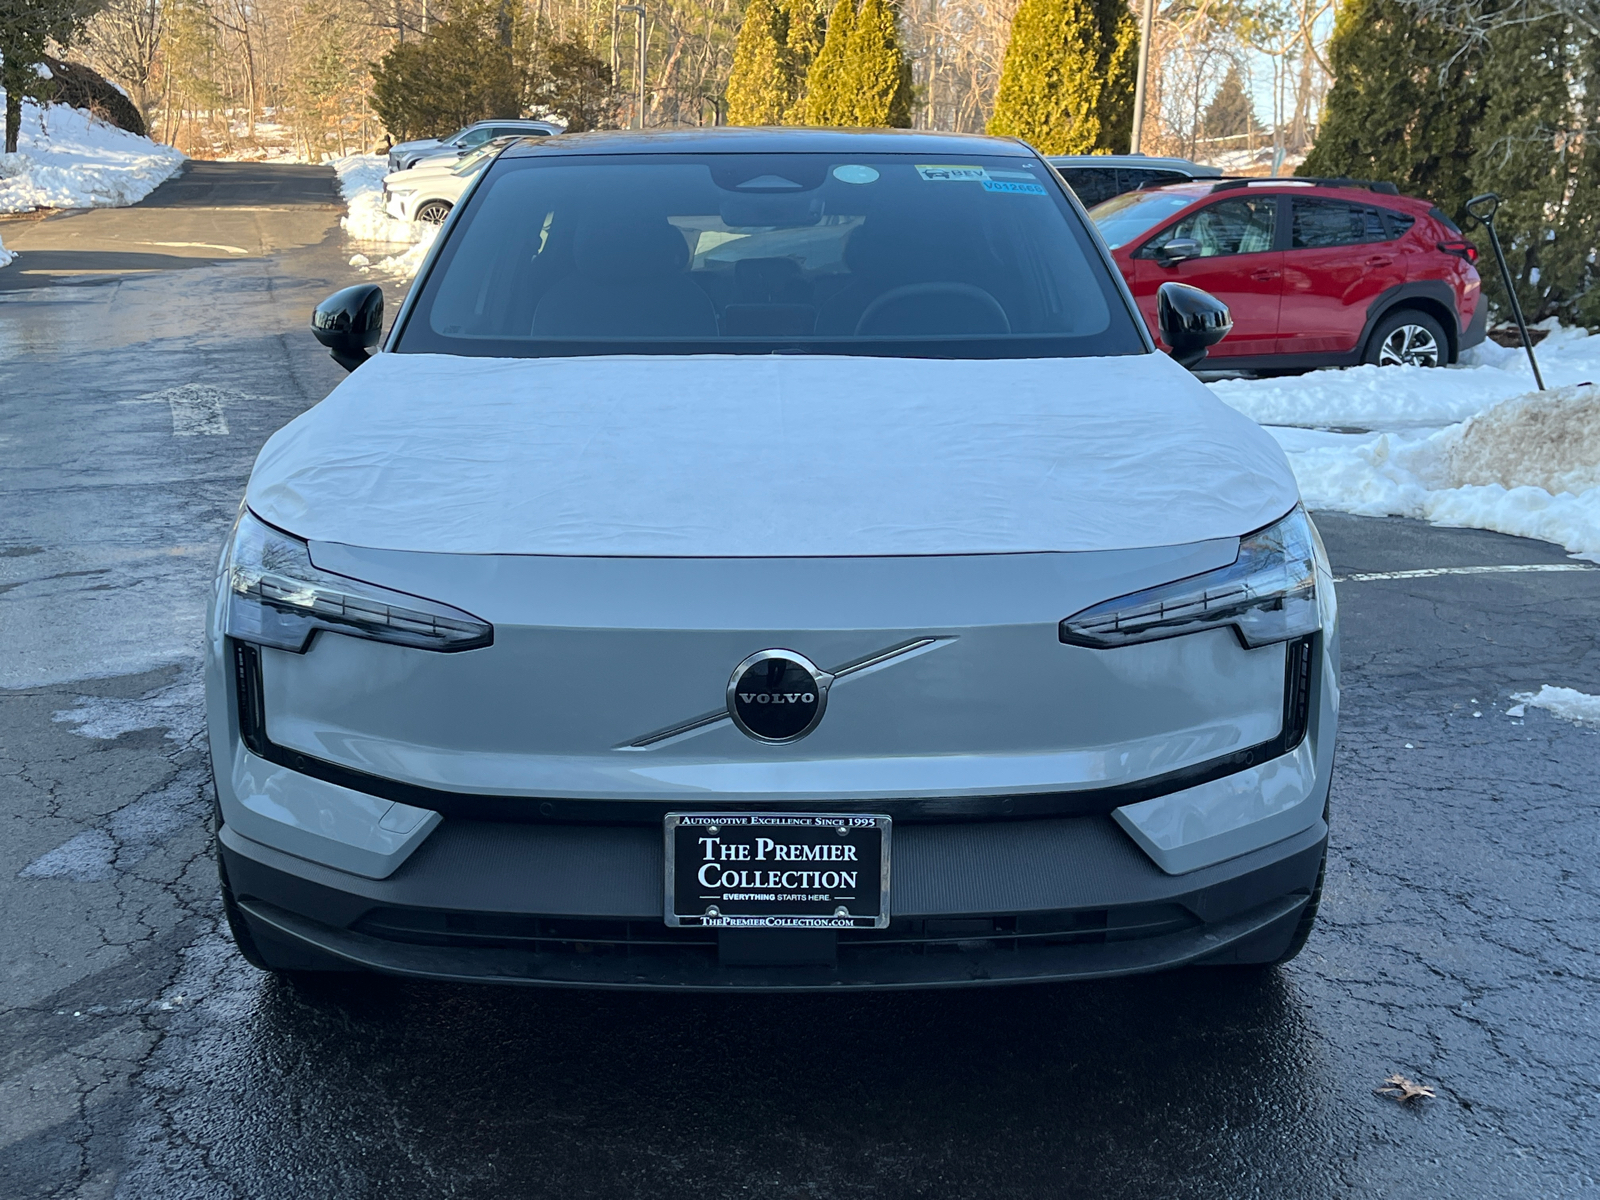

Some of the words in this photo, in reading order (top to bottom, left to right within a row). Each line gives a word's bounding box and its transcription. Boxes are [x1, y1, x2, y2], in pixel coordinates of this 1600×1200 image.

[951, 169, 983, 177] BEV
[739, 692, 815, 704] VOLVO
[682, 816, 748, 825] AUTOMOTIVE
[750, 816, 812, 825] EXCELLENCE
[814, 817, 845, 826] SINCE
[848, 818, 876, 827] 1995
[698, 837, 750, 861] THE
[755, 837, 858, 861] PREMIER
[697, 863, 858, 889] COLLECTION
[723, 893, 775, 901] EVERYTHING
[777, 893, 807, 901] STARTS
